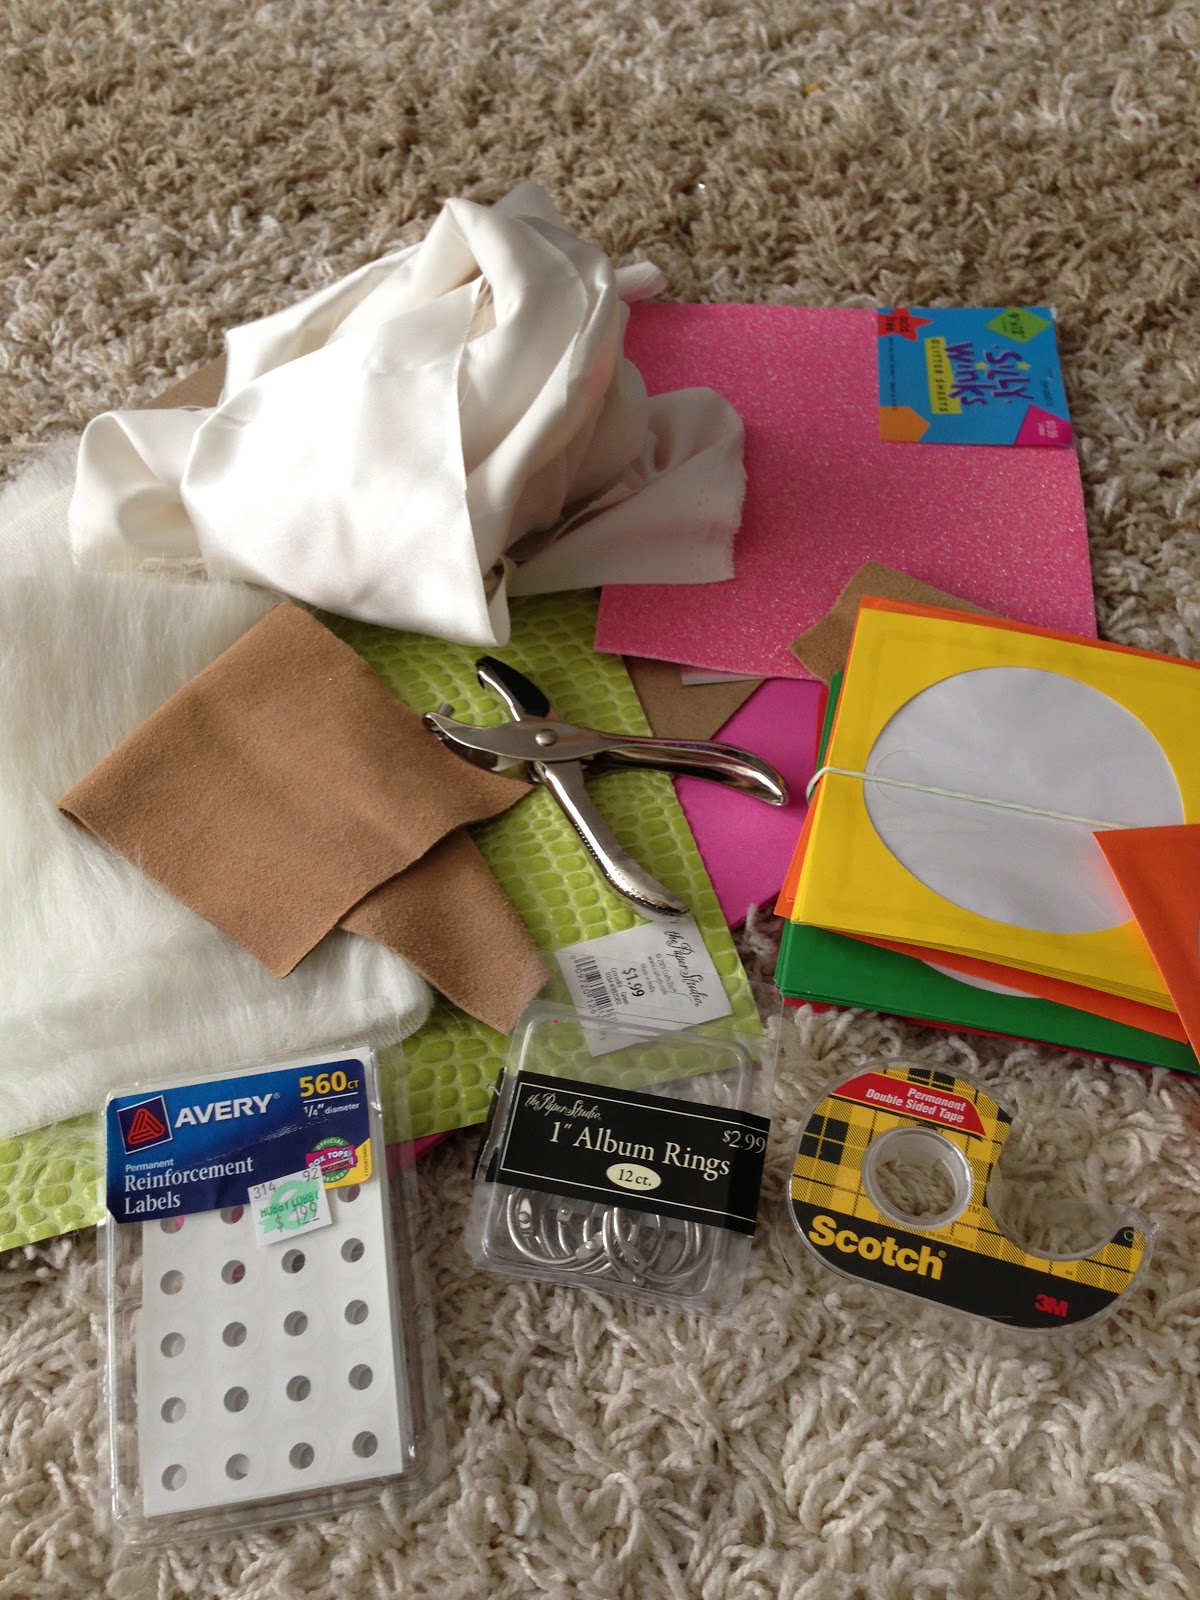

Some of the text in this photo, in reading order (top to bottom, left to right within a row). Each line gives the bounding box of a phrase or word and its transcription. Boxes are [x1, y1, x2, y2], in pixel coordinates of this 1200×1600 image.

[930, 339, 949, 412] GLITTER SHEETS
[664, 930, 708, 1004] the Paper Studio
[622, 967, 645, 998] $1.99
[299, 1071, 347, 1098] 560
[174, 1093, 274, 1129] AVERY
[324, 1102, 360, 1116] diameter
[524, 1092, 601, 1121] the Paper Studio
[864, 1088, 965, 1124] Double Sided Tape
[907, 1087, 967, 1112] Permanent
[549, 1121, 731, 1181] 1" Album Rings
[722, 1130, 767, 1154] $2.99
[124, 1157, 254, 1193] Reinforcement
[125, 1159, 174, 1172] Permanent
[308, 1155, 326, 1168] BOX
[617, 1168, 634, 1183] 12
[253, 1167, 320, 1199] 314 92
[124, 1193, 181, 1216] Labels
[808, 1215, 943, 1281] Scotch
[1034, 1293, 1069, 1319] 3M
